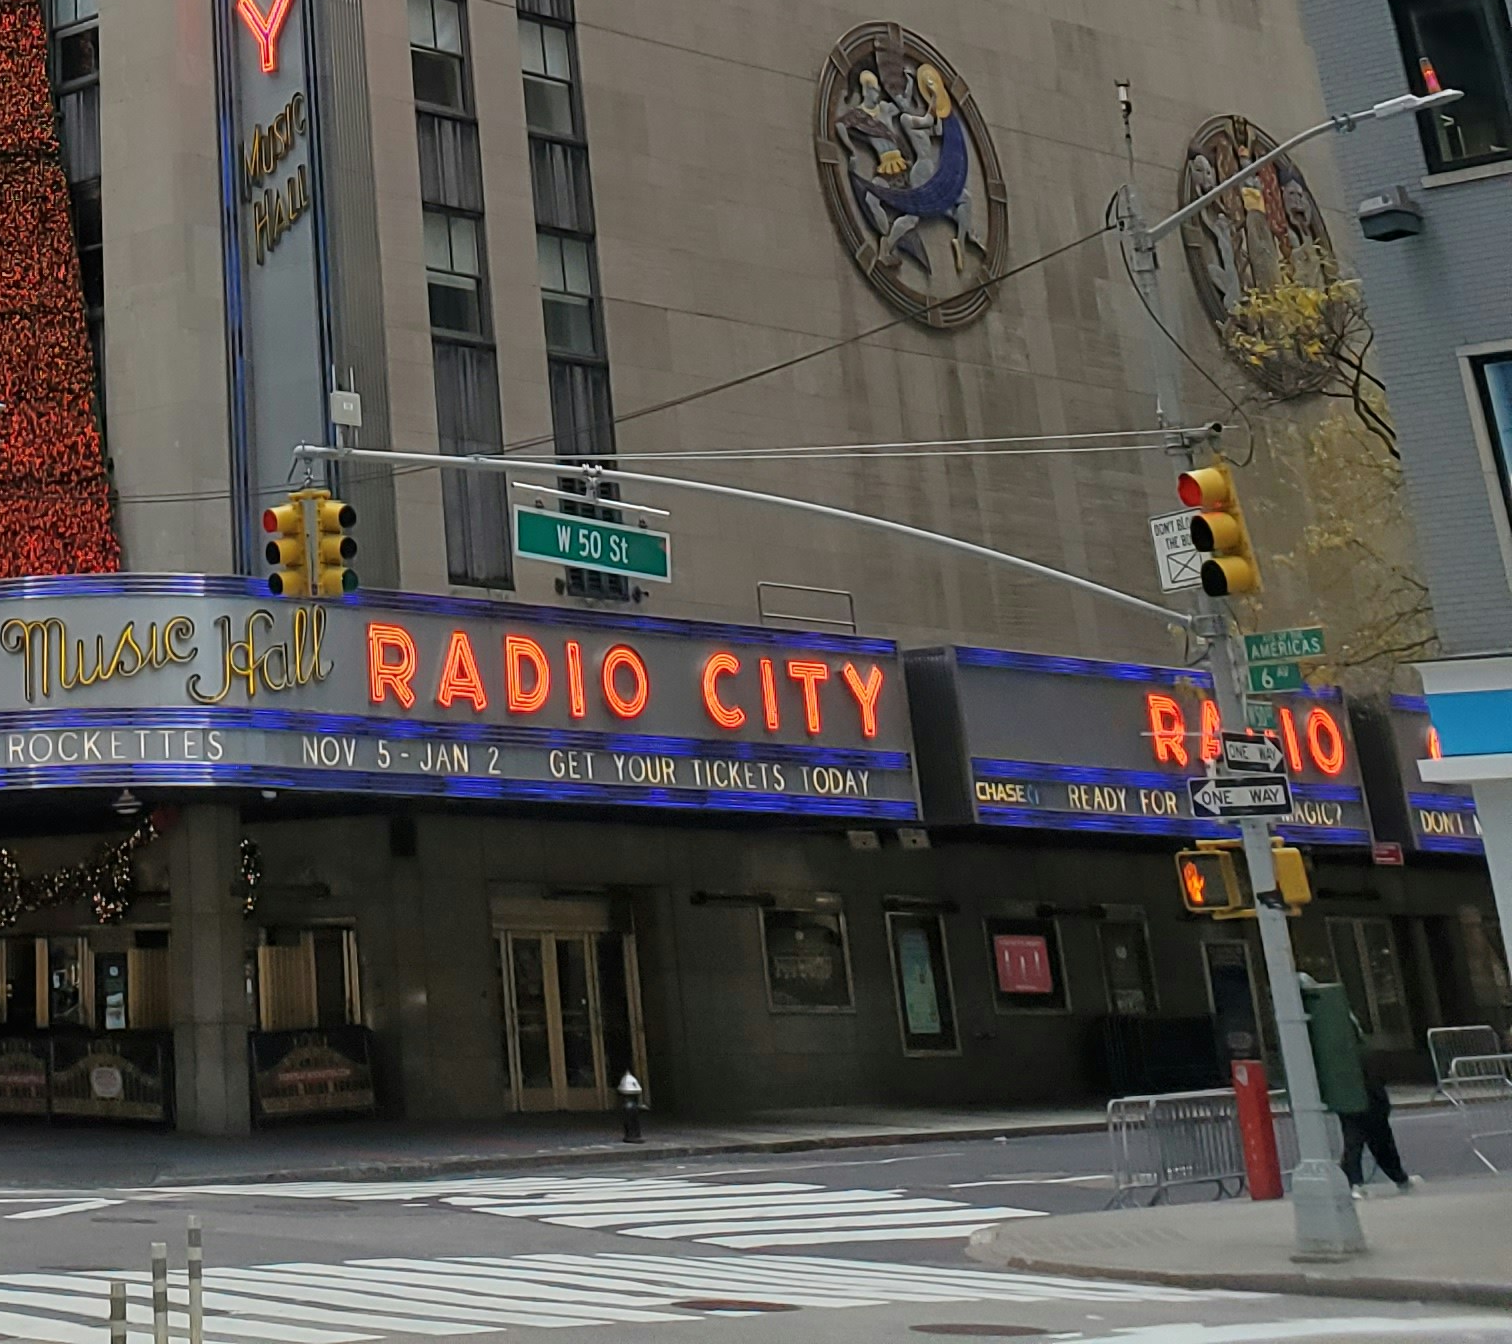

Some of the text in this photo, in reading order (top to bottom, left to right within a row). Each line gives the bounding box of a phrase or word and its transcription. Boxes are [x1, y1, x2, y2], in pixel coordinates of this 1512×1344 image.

[556, 523, 629, 564] W 50 St
[0, 604, 334, 705] Music Hall
[1251, 638, 1321, 660] AMERICAS
[368, 621, 885, 739] RADIO CITY
[1261, 668, 1274, 689] 6
[7, 729, 224, 764] ROCKETTES
[302, 735, 356, 767] NOV
[377, 740, 391, 769] 5
[419, 744, 469, 773] JAN
[487, 746, 502, 775] 2
[1229, 743, 1277, 762] ONE WAY
[549, 749, 870, 797] GET YOUR TICKETS TODAY
[975, 781, 1026, 803] CHASE
[1068, 784, 1126, 812] READY
[1139, 788, 1178, 815] FOR
[1201, 787, 1280, 806] ONE WAY
